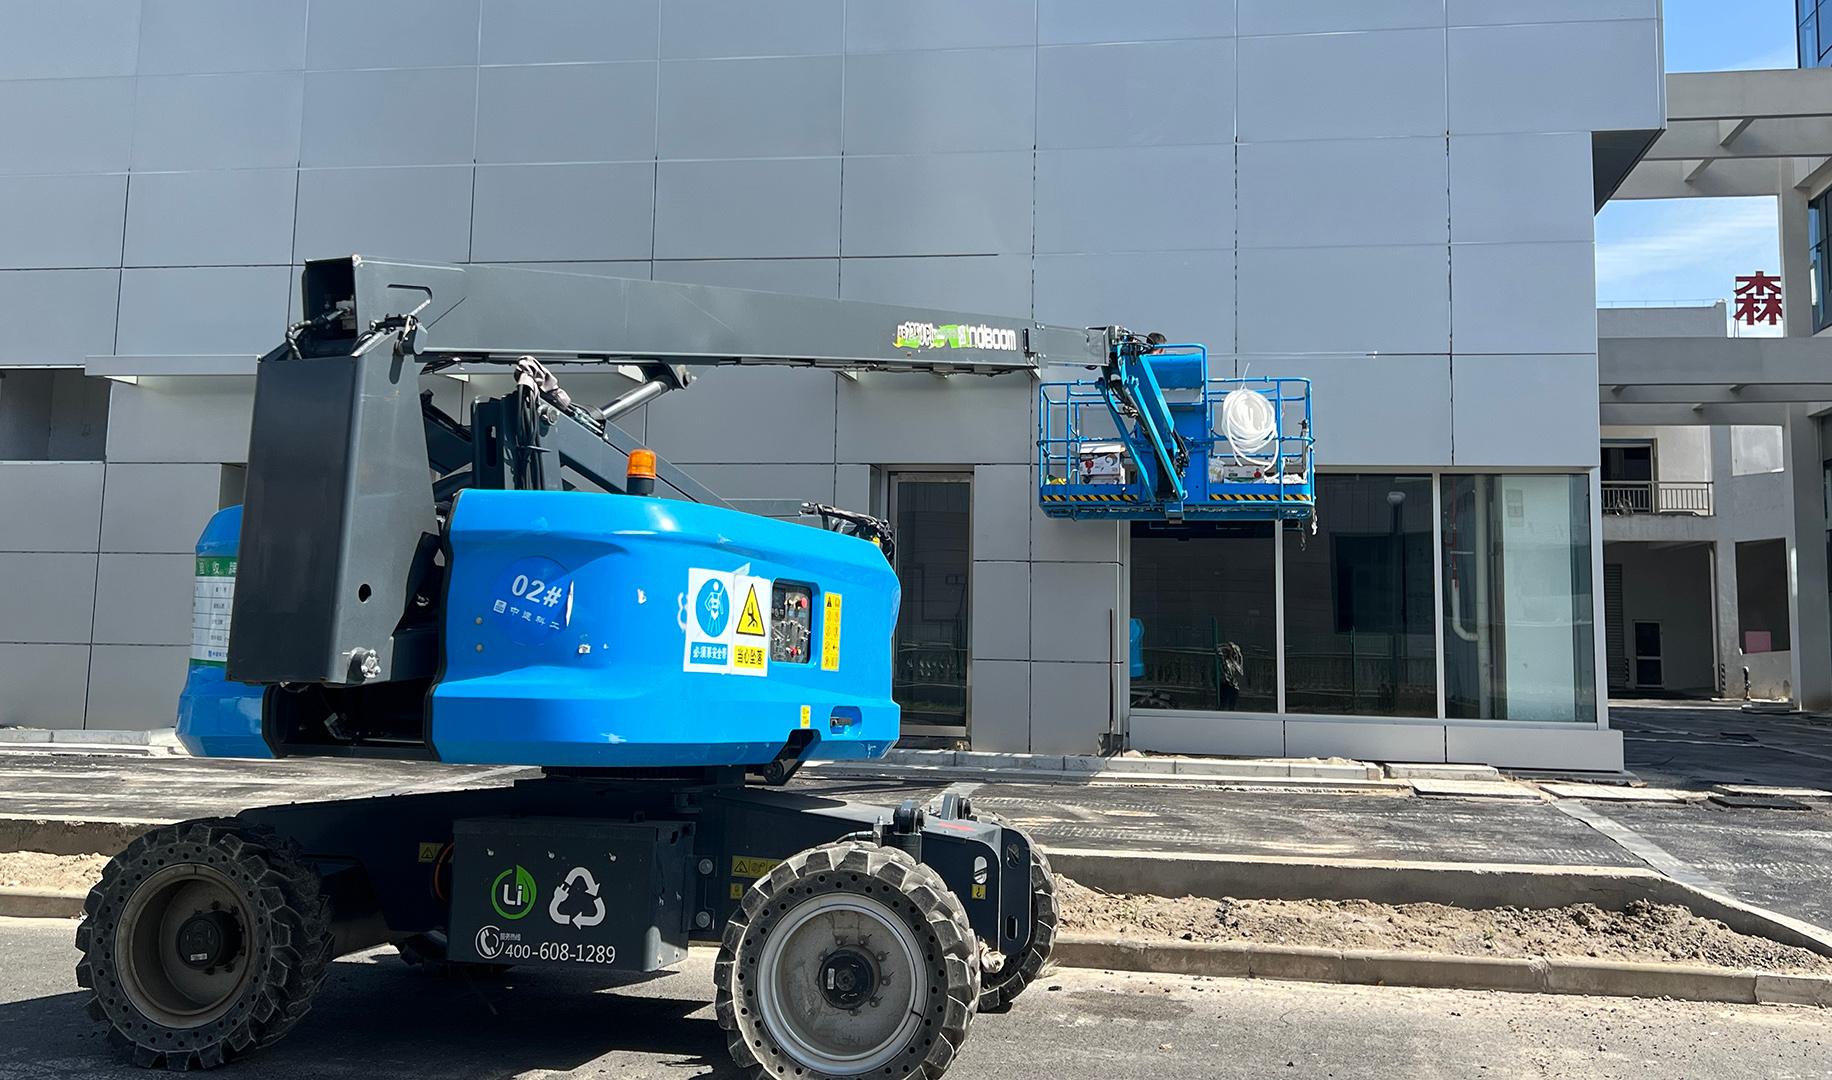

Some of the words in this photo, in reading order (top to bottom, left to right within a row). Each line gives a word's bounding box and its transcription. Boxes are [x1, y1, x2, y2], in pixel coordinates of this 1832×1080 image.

[1733, 271, 1783, 325] 森
[511, 574, 563, 608] 02#
[503, 883, 523, 906] Li
[504, 942, 616, 964] 400-608-1289
